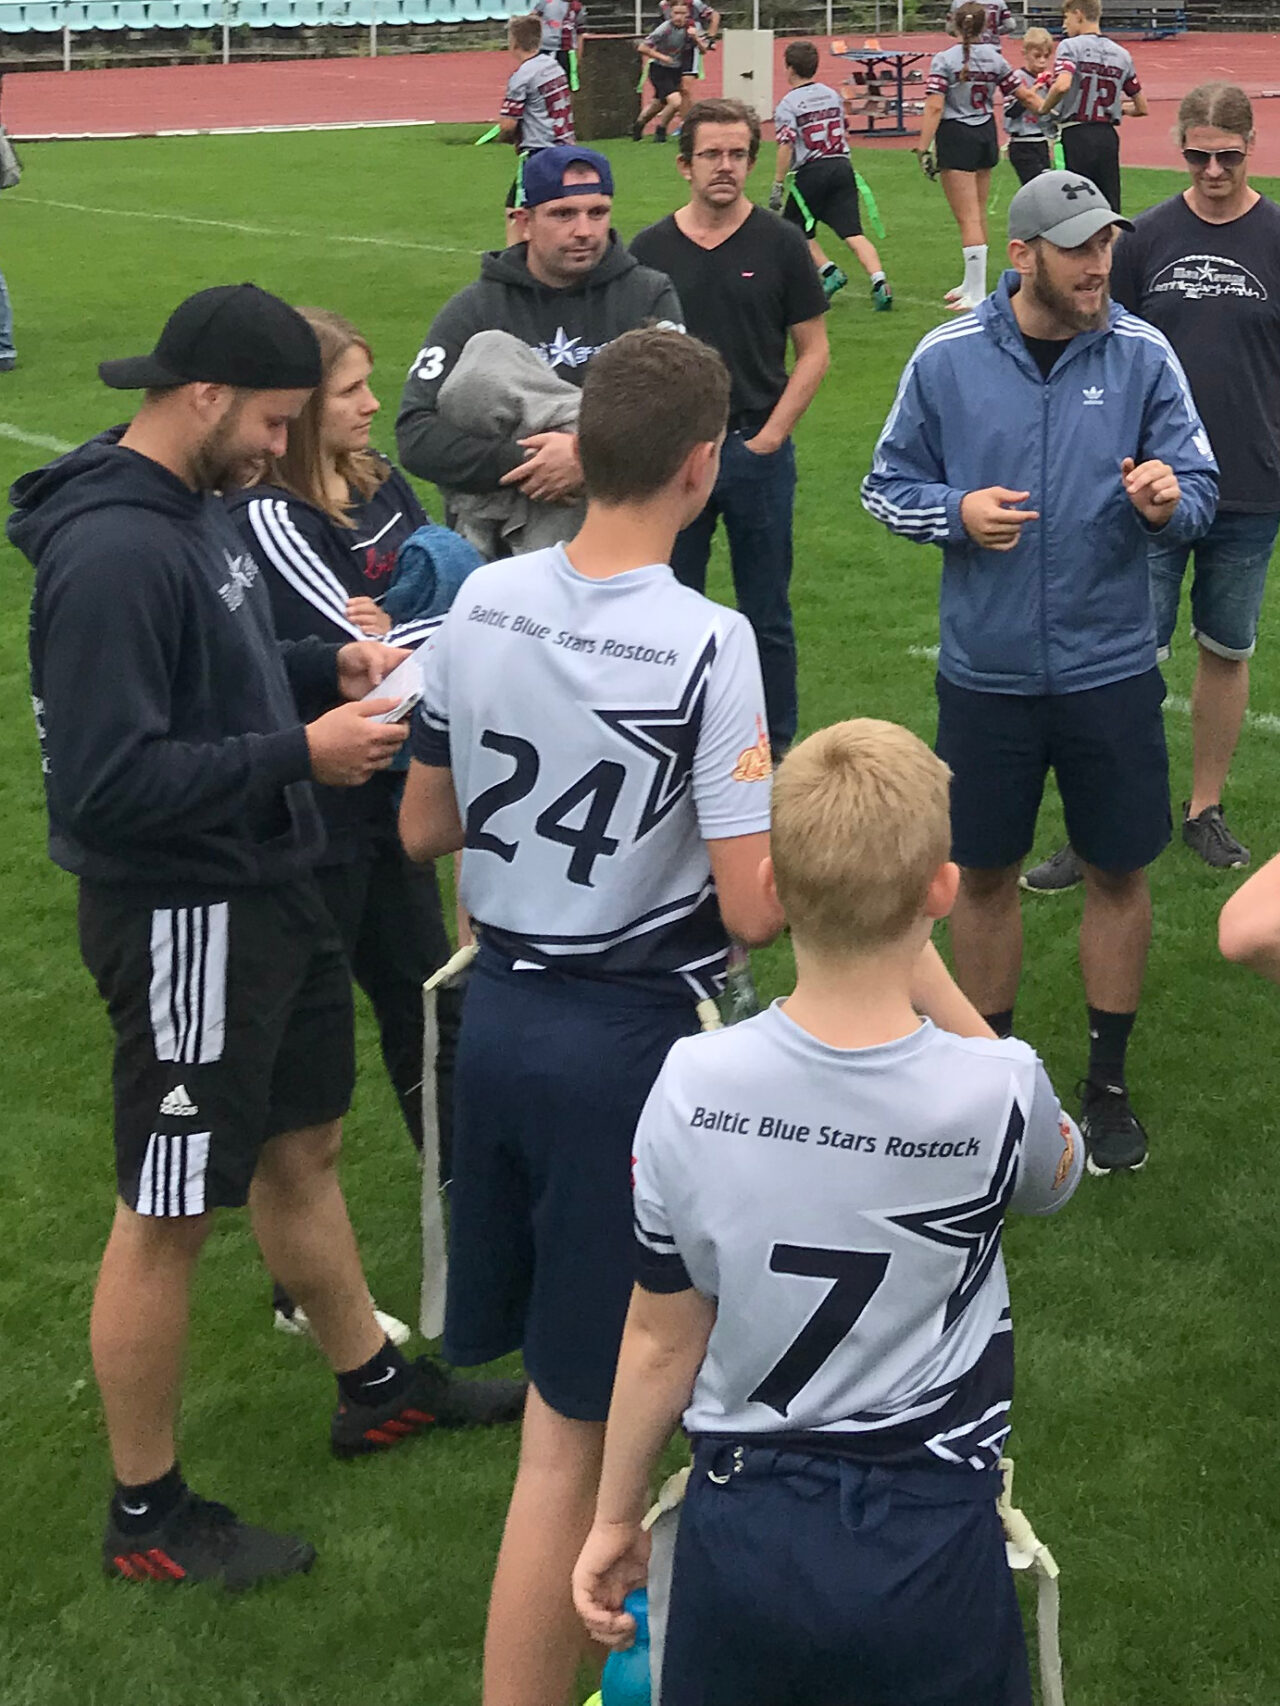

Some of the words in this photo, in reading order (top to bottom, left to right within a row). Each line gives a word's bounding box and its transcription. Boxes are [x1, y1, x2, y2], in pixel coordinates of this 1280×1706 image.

[467, 604, 507, 629] Baltic
[510, 615, 551, 640] Blue
[553, 631, 596, 655] Stars
[600, 639, 681, 667] Rostock
[464, 729, 628, 889] 24
[690, 1107, 750, 1136] Baltic
[757, 1117, 810, 1143] Blue
[817, 1126, 877, 1153] Stars
[885, 1136, 981, 1159] Rostock
[747, 1243, 892, 1417] 7
